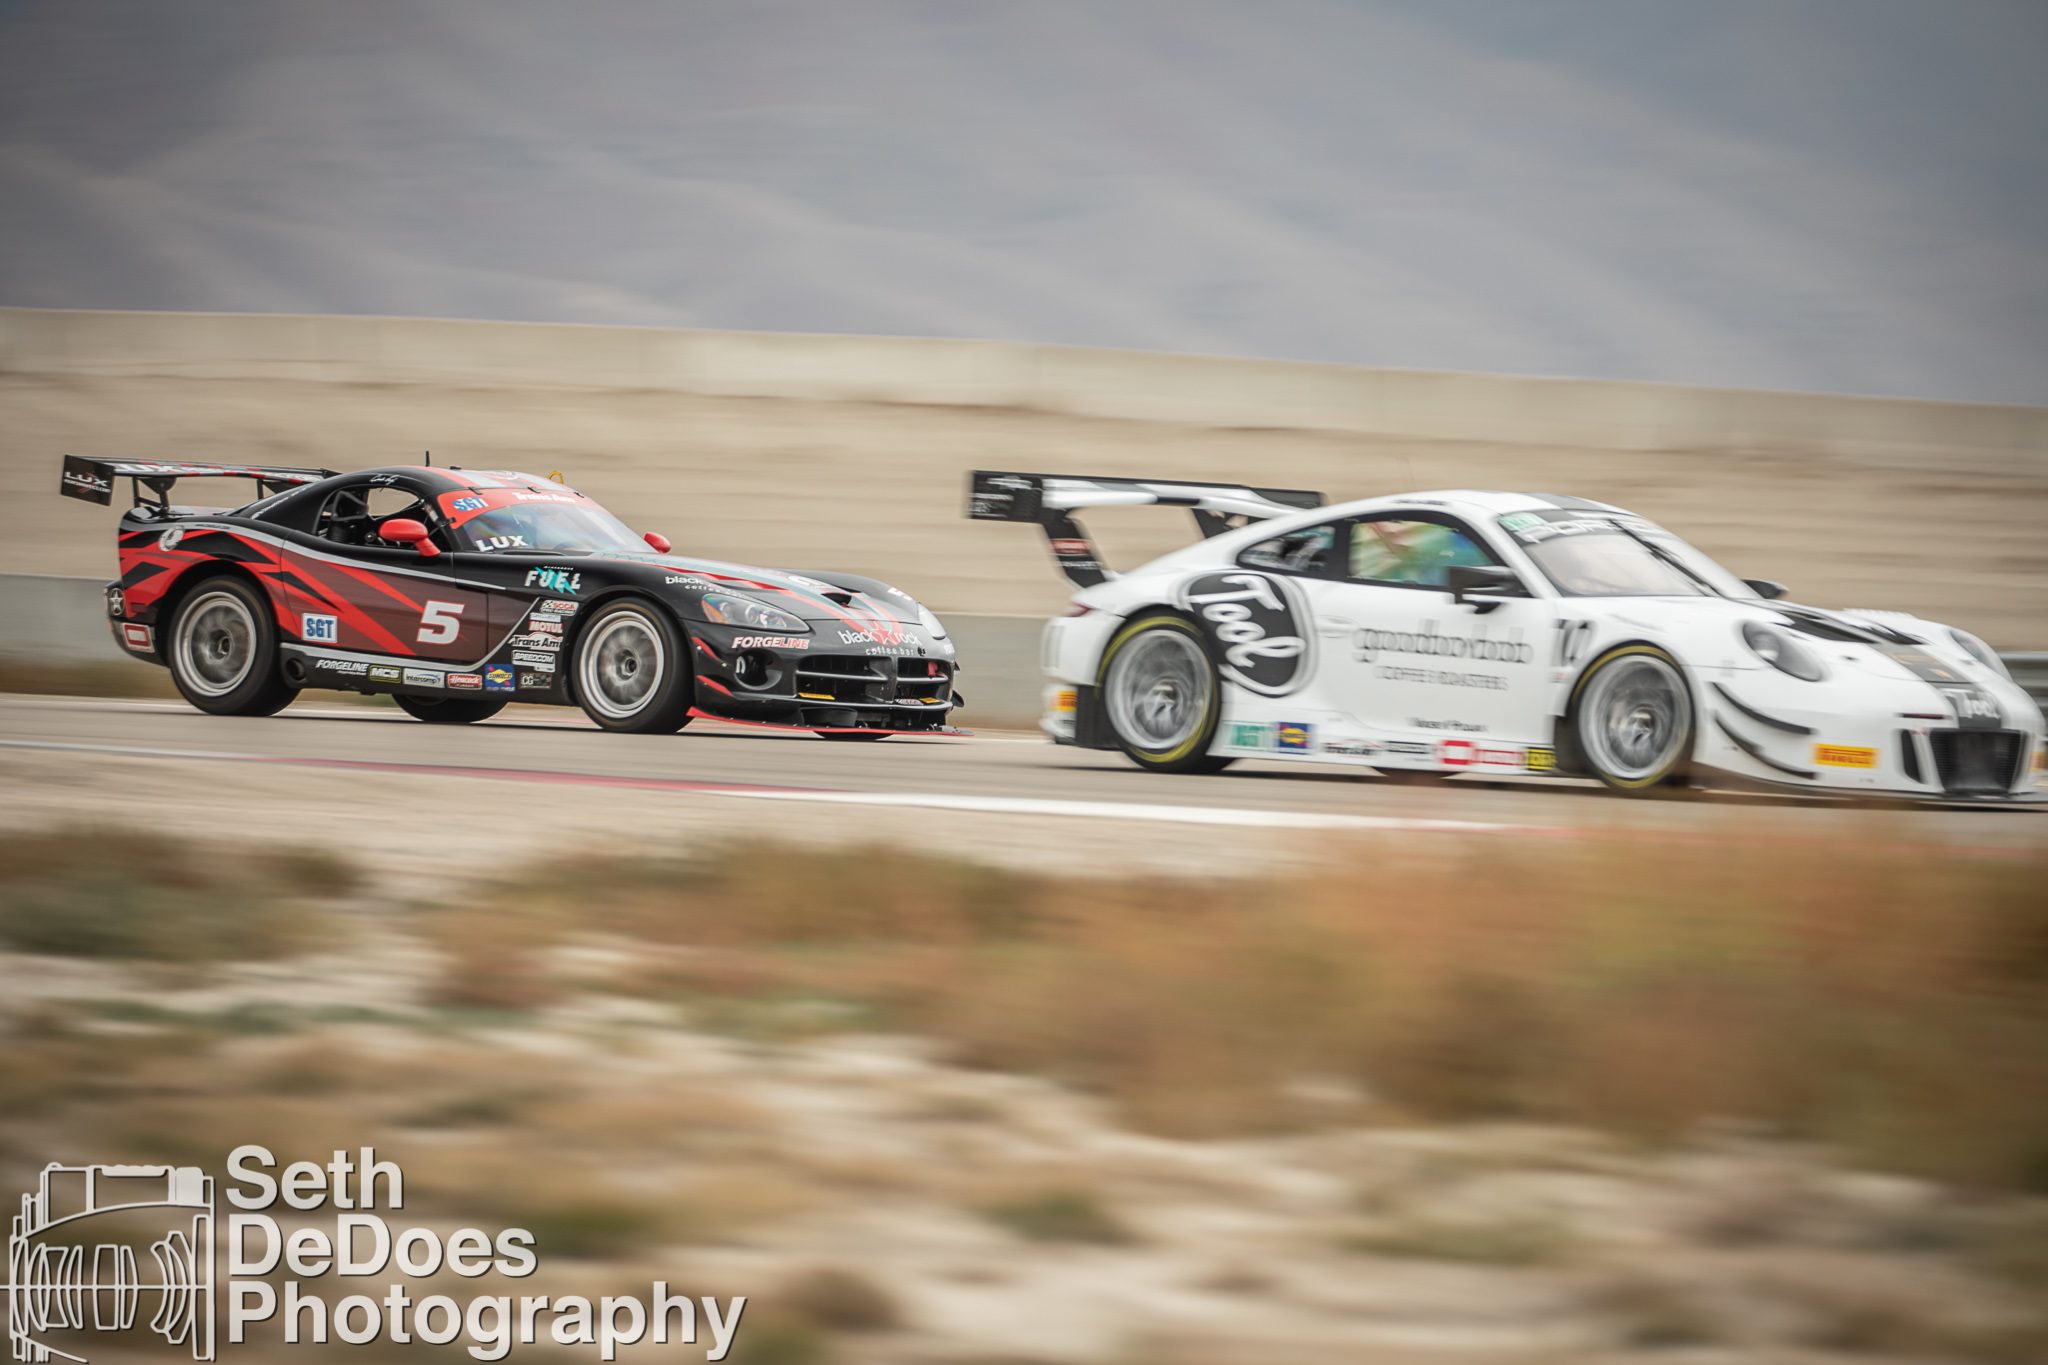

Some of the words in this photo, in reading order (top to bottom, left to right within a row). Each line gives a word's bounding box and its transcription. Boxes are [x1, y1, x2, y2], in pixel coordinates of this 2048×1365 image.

[452, 496, 489, 512] SGT
[475, 535, 528, 552] LUX
[524, 570, 581, 590] FUEL
[552, 602, 576, 610] SCCA
[306, 618, 334, 640] SGT
[416, 600, 466, 645] 5
[530, 621, 563, 633] MOTUL
[513, 637, 540, 646] Trans
[541, 638, 559, 647] Am
[731, 636, 810, 650] FORGELINE
[837, 629, 877, 644] black
[893, 632, 923, 646] rock
[865, 646, 897, 656] coffee
[899, 648, 914, 656] bar
[315, 659, 369, 672] FORGELINE
[371, 667, 399, 679] MCS
[406, 673, 437, 684] intercomp
